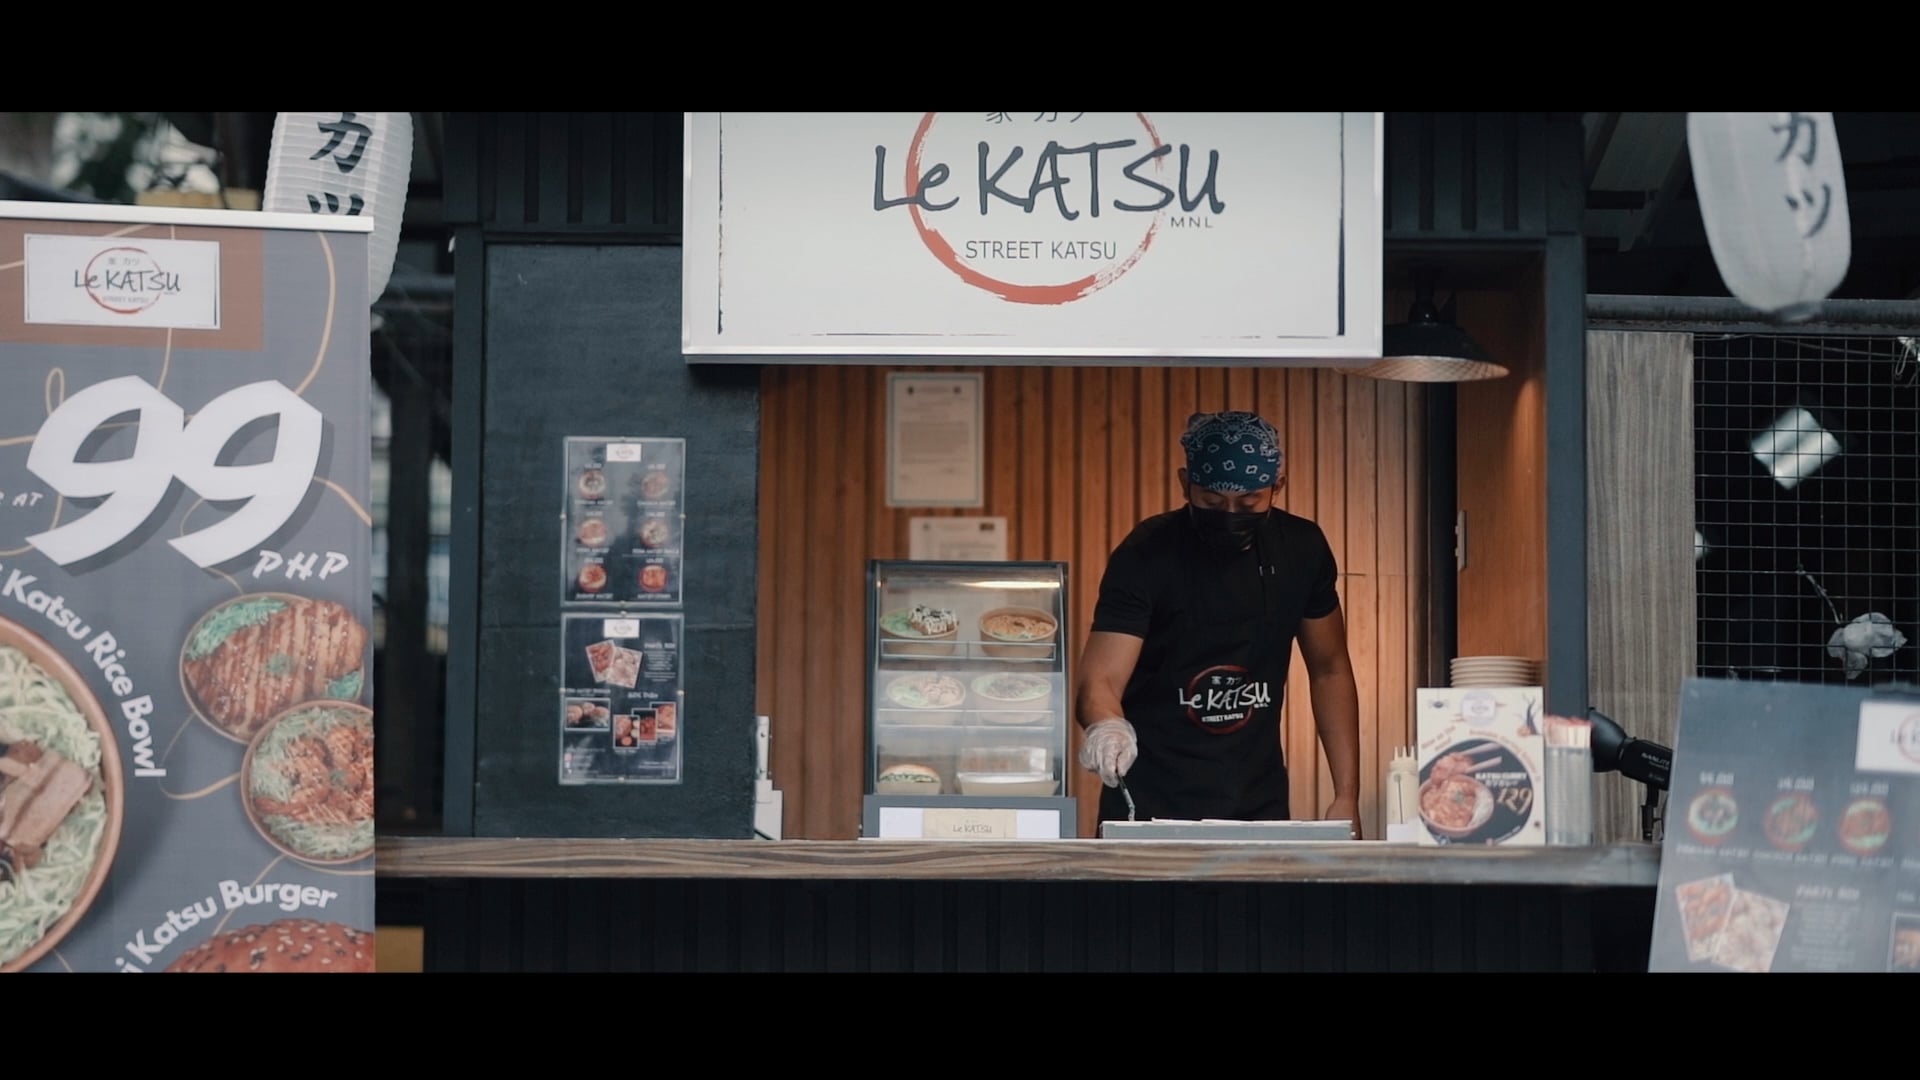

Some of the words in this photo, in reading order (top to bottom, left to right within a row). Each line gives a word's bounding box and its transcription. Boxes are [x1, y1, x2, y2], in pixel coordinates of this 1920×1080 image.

[874, 145, 959, 211] Le
[977, 139, 1225, 220] KATSU
[1171, 216, 1213, 228] MNL
[966, 241, 1043, 259] STREET
[1051, 241, 1117, 260] KATSU
[74, 269, 100, 288] Le
[106, 269, 181, 292] KATSU
[25, 375, 323, 568] 99
[12, 491, 43, 507] AT
[252, 550, 349, 580] PHP
[2, 568, 91, 640] Katsu
[84, 630, 134, 697] Rice
[121, 694, 167, 777] Bowl
[1179, 687, 1203, 709] Le
[1207, 682, 1271, 711] KATSU
[125, 896, 218, 965] Katsu
[218, 879, 338, 912] Burger
